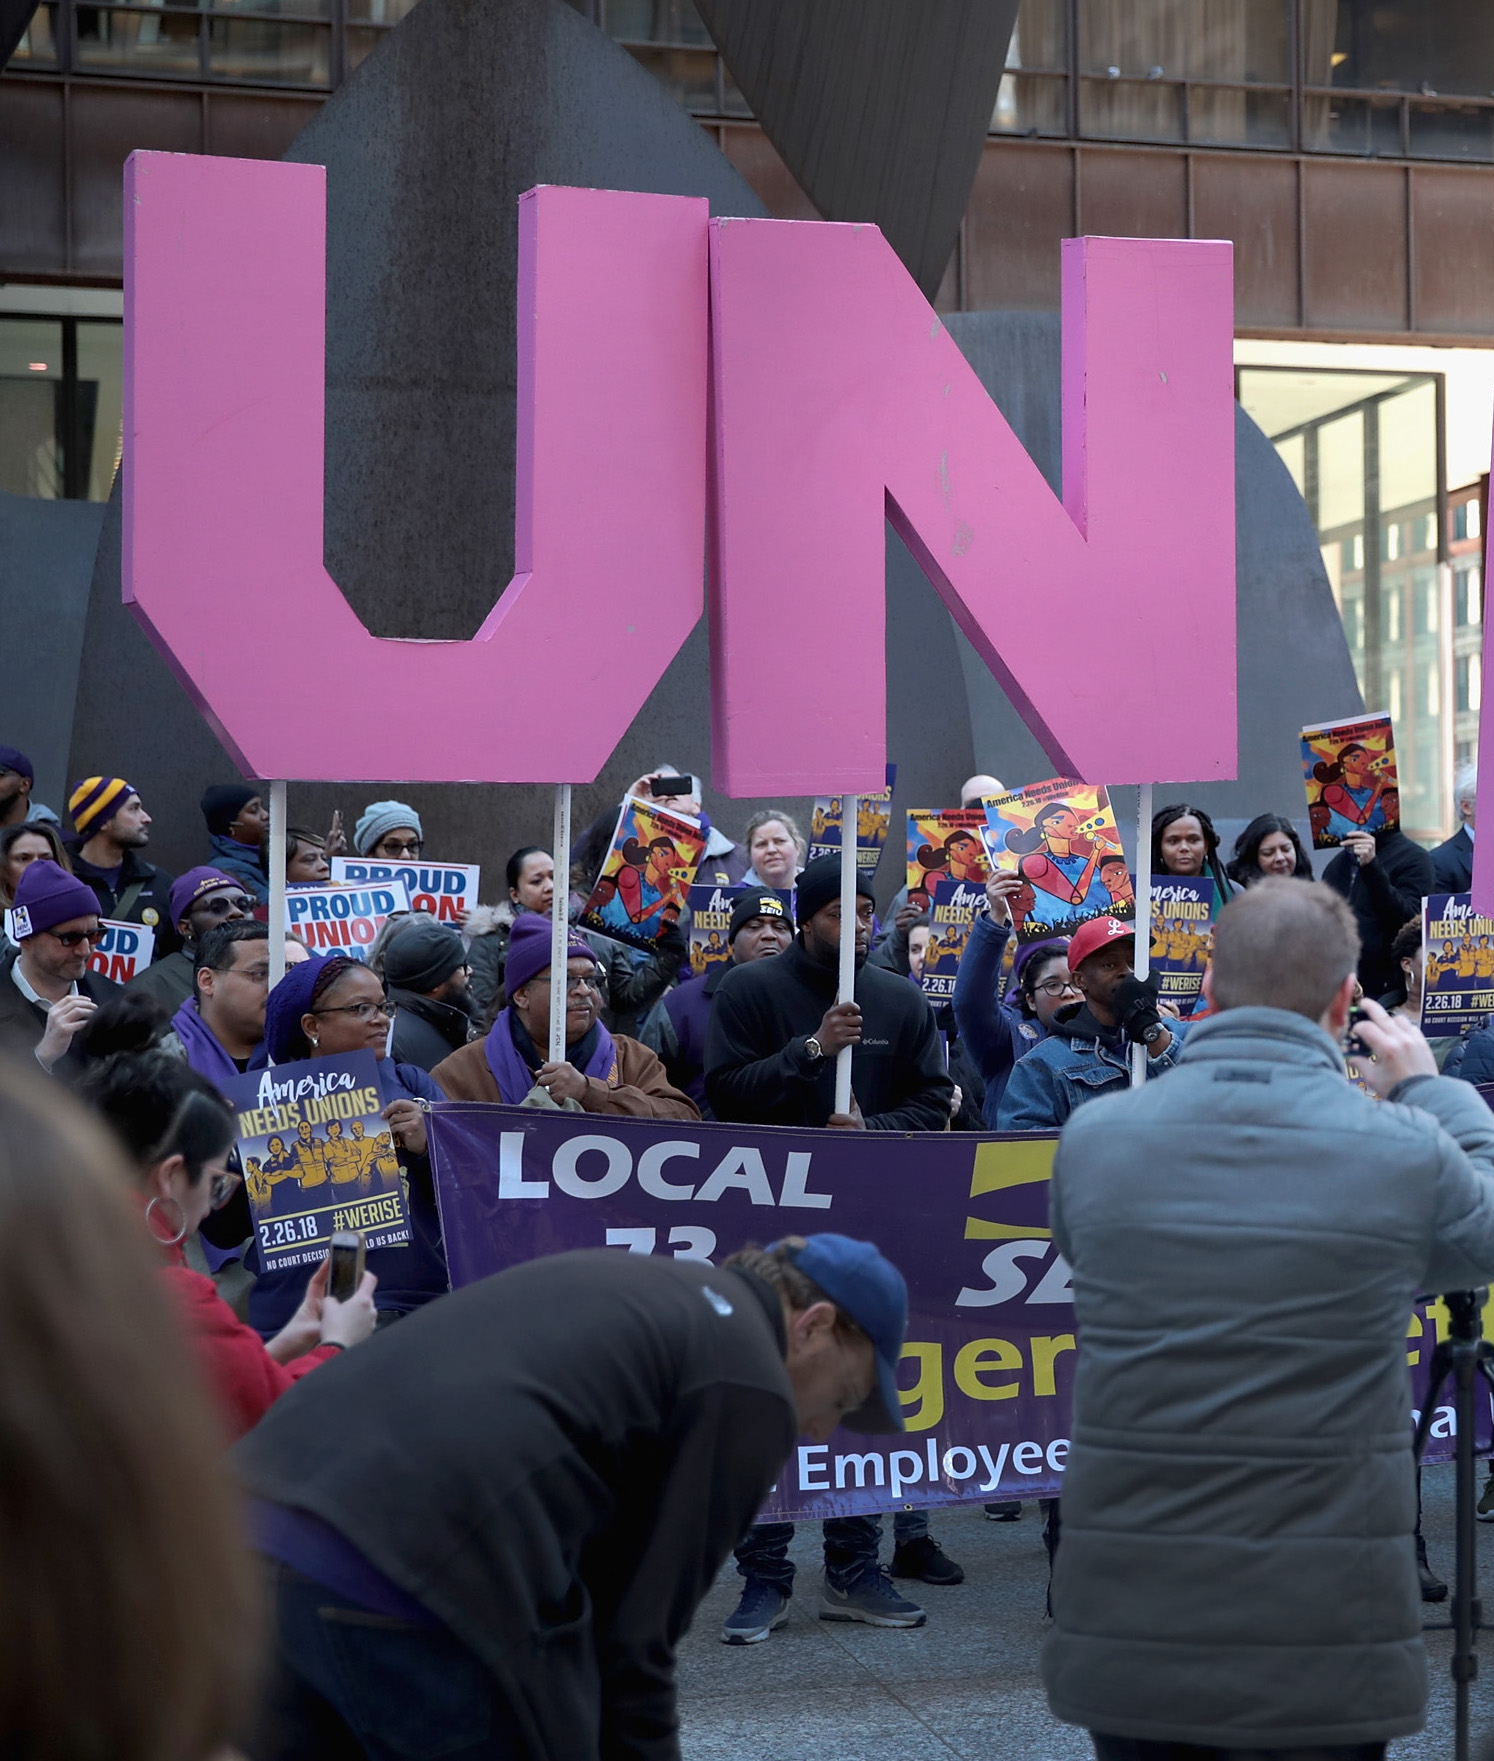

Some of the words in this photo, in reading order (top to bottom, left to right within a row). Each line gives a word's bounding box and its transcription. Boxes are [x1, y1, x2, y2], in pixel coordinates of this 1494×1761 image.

[986, 792, 1025, 809] America
[1025, 786, 1053, 799] Needs
[287, 890, 396, 923] PROUD
[1149, 885, 1200, 903] merica
[759, 906, 783, 917] SEIU
[934, 904, 973, 925] NEEDS
[1163, 900, 1210, 921] UNIONS
[291, 915, 389, 948] UNIO
[1430, 920, 1466, 939] NEEDS
[1161, 976, 1202, 991] #WERISE
[1425, 995, 1462, 1010] 2.26.18
[256, 1070, 356, 1120] America
[238, 1102, 302, 1140] NEEDS
[302, 1086, 382, 1128] UNIONS
[498, 1131, 833, 1209] LOCAL
[332, 1197, 404, 1232] #WERISE
[258, 1215, 319, 1248] 2.26.18
[266, 1258, 277, 1272] NO
[278, 1254, 301, 1269] COURT
[303, 1248, 330, 1264] DECISIO
[376, 1235, 387, 1247] US
[387, 1229, 410, 1244] BACK!
